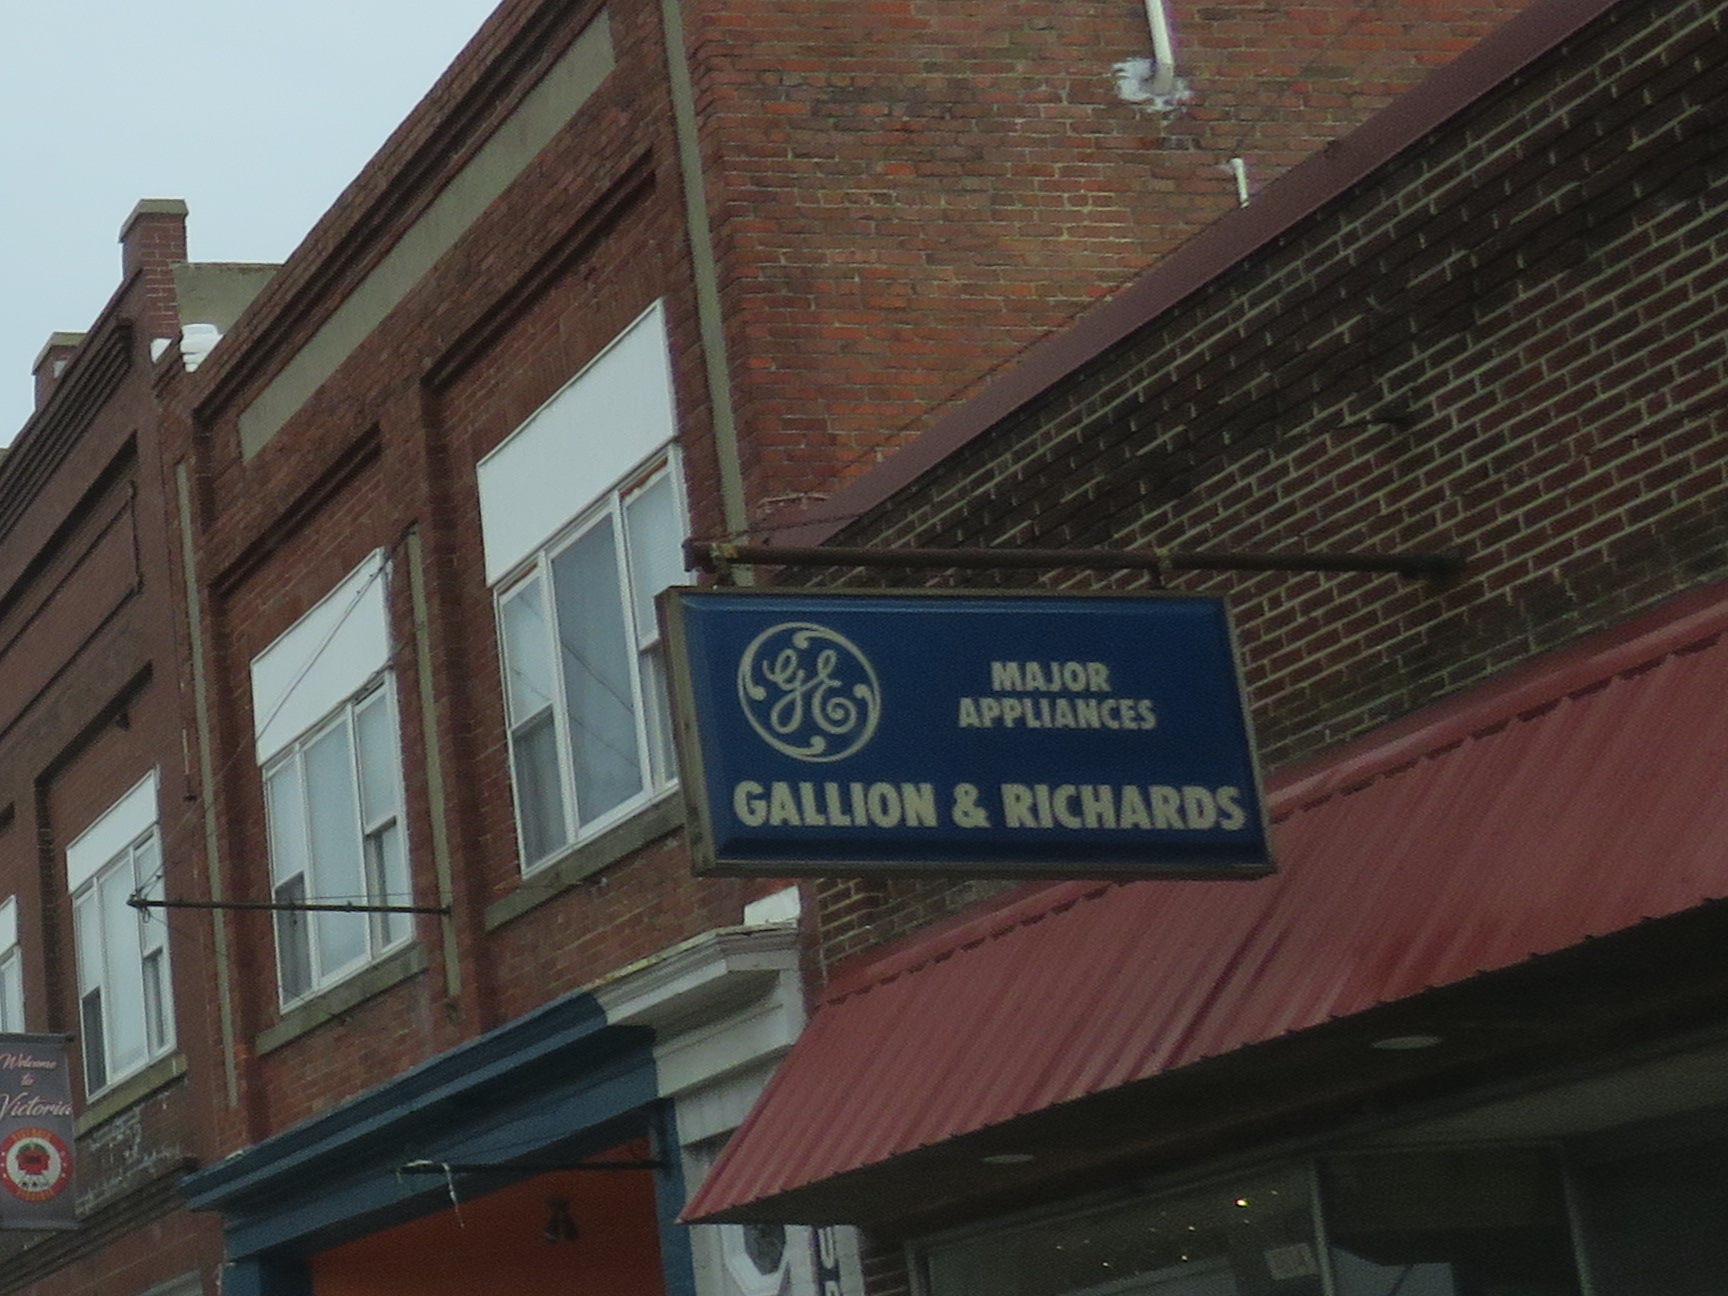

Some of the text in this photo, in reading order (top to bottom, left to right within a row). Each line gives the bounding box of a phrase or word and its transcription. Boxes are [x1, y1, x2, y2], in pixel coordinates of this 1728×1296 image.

[991, 661, 1111, 693] MAJOR
[957, 698, 1156, 731] APPLIANCES
[733, 780, 1247, 831] GALLION & RICHARDS
[21, 1072, 36, 1087] to
